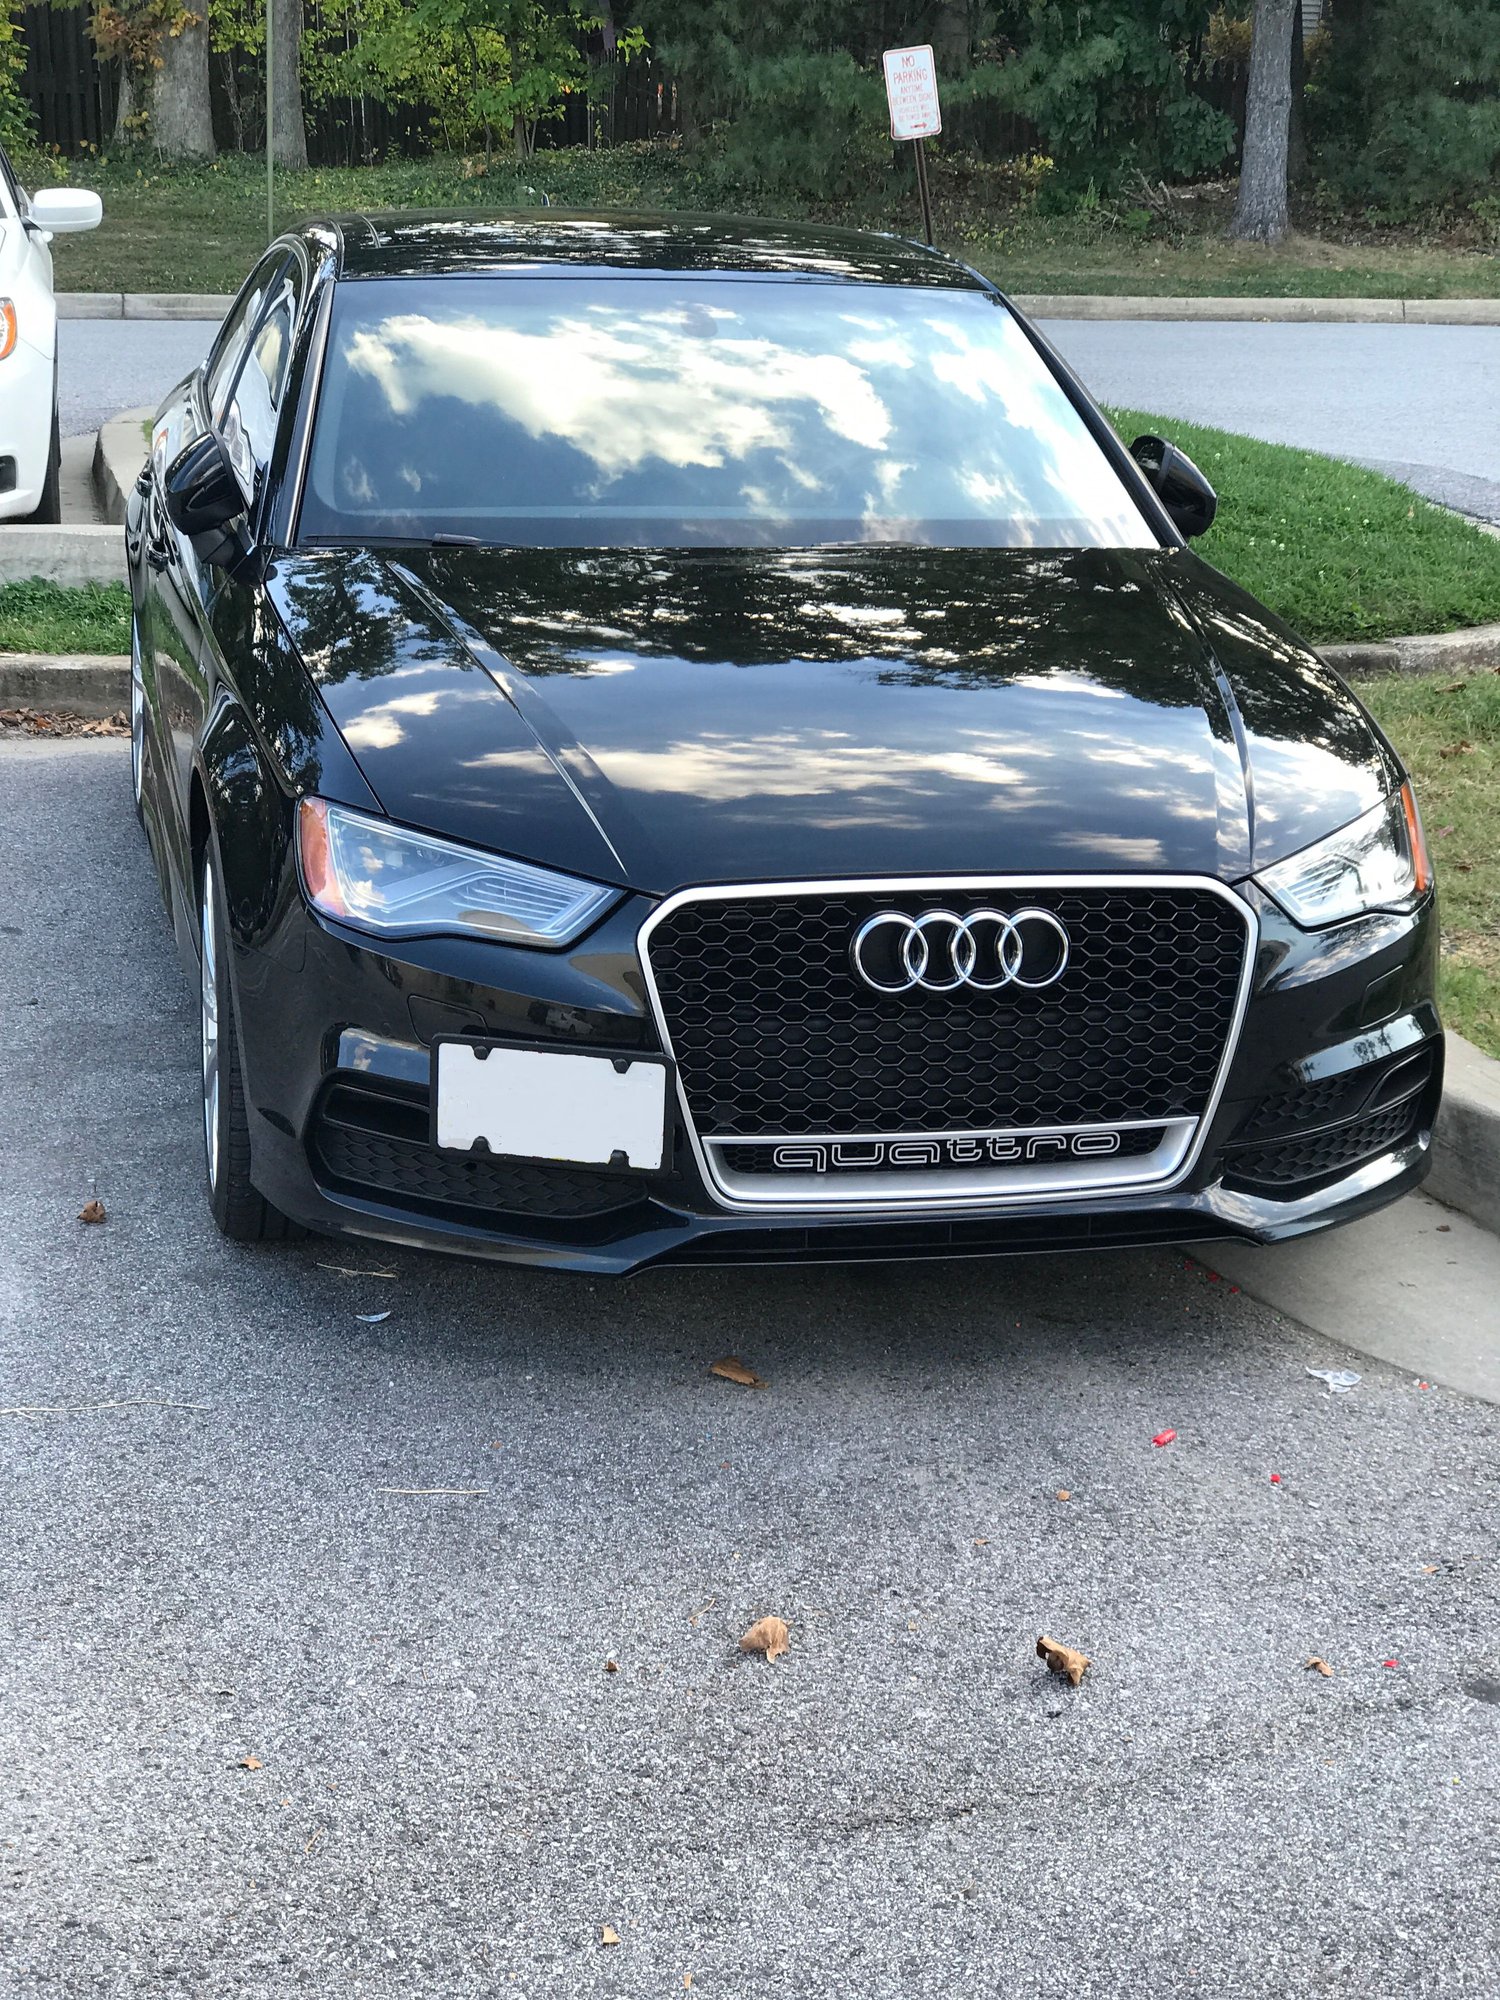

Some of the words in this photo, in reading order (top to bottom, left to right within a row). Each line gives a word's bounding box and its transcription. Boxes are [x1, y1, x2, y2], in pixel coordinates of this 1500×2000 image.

[901, 55, 915, 68] NO
[893, 68, 928, 84] PARKING
[900, 84, 923, 94] ANYTIME
[773, 1131, 1121, 1172] quattro
